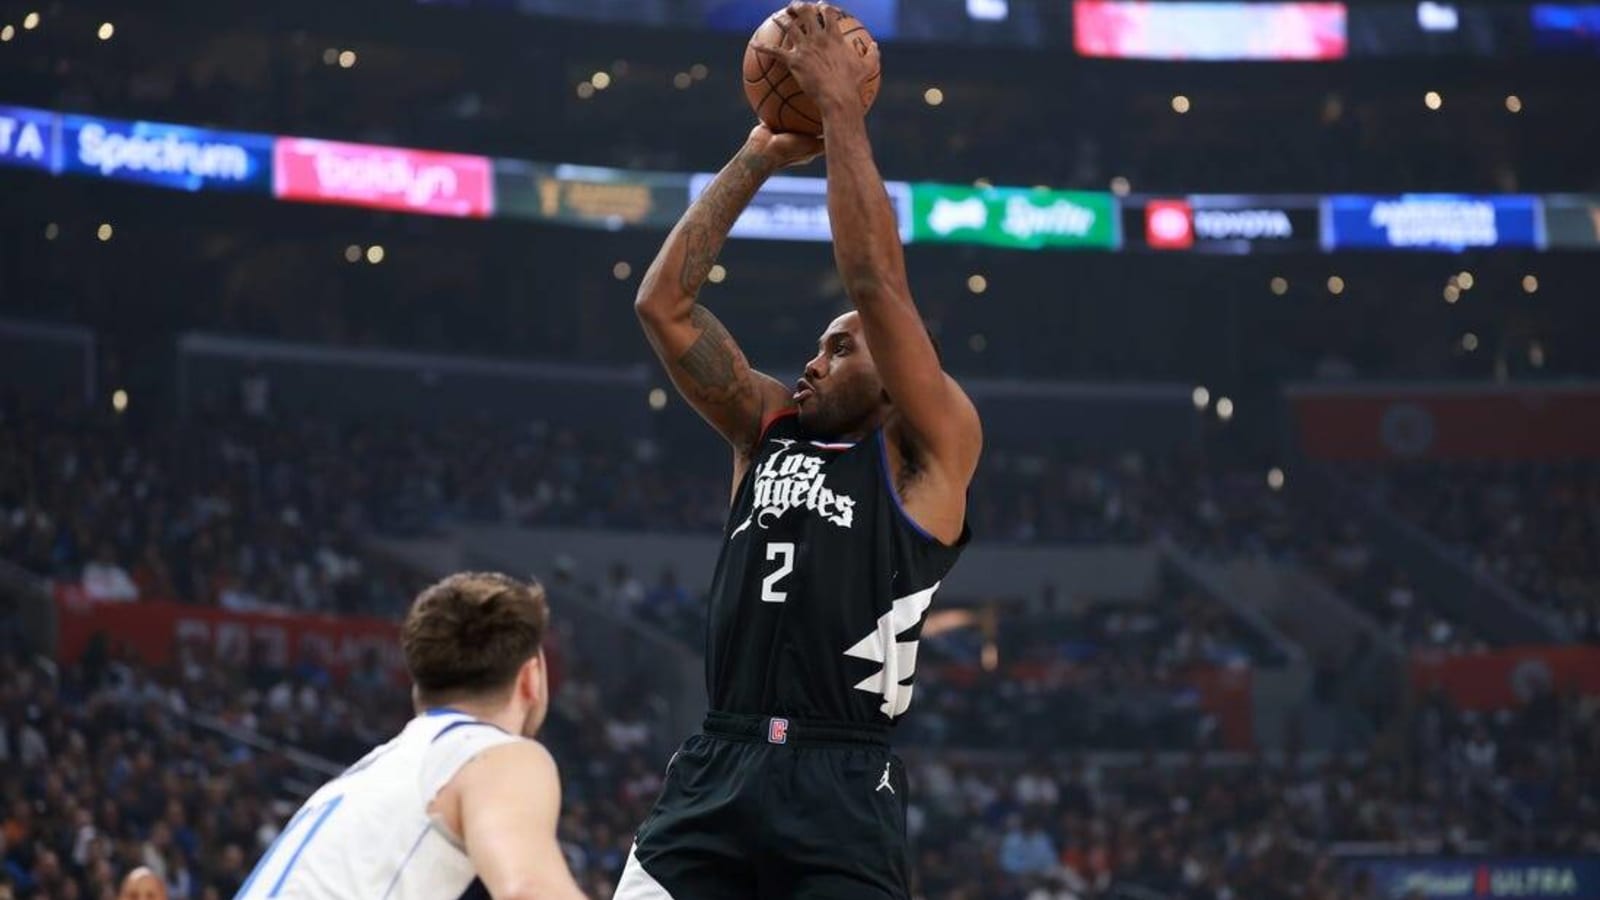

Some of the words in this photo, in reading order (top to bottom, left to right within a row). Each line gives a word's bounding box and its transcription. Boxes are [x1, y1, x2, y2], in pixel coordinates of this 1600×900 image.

[78, 122, 249, 181] Spectrum
[1194, 209, 1293, 239] TOYOTA
[760, 451, 826, 480] Los
[761, 541, 795, 602] 2
